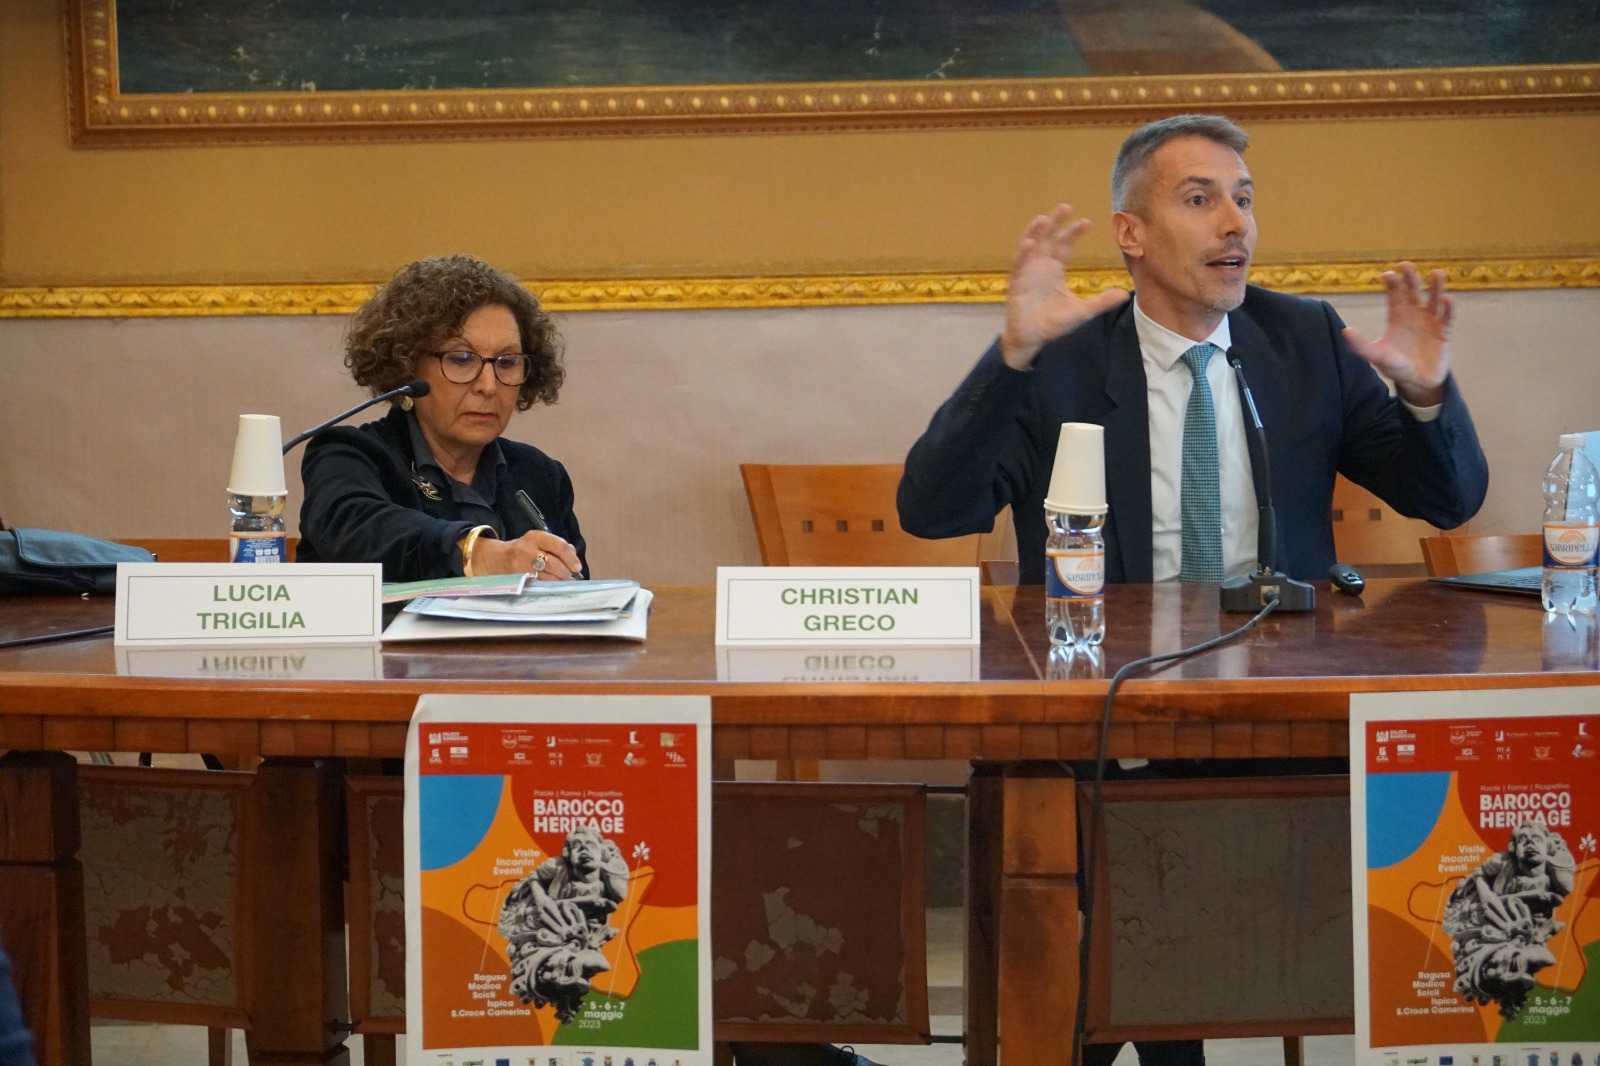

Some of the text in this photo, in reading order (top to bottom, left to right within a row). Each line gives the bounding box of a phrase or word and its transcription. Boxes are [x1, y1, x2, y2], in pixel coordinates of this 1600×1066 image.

[213, 584, 290, 602] LUCIA
[781, 588, 919, 605] CHRISTIAN
[197, 611, 306, 630] TRIGILIA
[804, 614, 896, 632] GRECO
[1479, 791, 1571, 811] BAROCCO
[533, 799, 624, 816] BAROCCO
[1479, 809, 1571, 829] HERITAGE
[533, 816, 624, 833] HERITAGE
[513, 848, 540, 857] Visite
[1458, 844, 1486, 853] Visite
[496, 857, 535, 866] Incontri
[1441, 853, 1480, 863] Incontri
[493, 866, 523, 875] Eventi
[1438, 862, 1468, 872] Eventi
[474, 973, 507, 983] Ragusa
[1418, 971, 1451, 981] Ragusa
[468, 982, 502, 990] Modica
[1412, 980, 1445, 988] Modica
[472, 991, 496, 999] Scicli
[1416, 989, 1440, 997] Scicli
[487, 1000, 514, 1008] Ispica
[1431, 997, 1458, 1006] Ispica
[451, 1007, 531, 1018] S.Croce Camerina
[1431, 1005, 1475, 1014] Camerina
[1529, 1004, 1570, 1016] maggio
[584, 1009, 624, 1021] maggio
[1523, 1014, 1546, 1024] 2023
[578, 1019, 601, 1029] 2023
